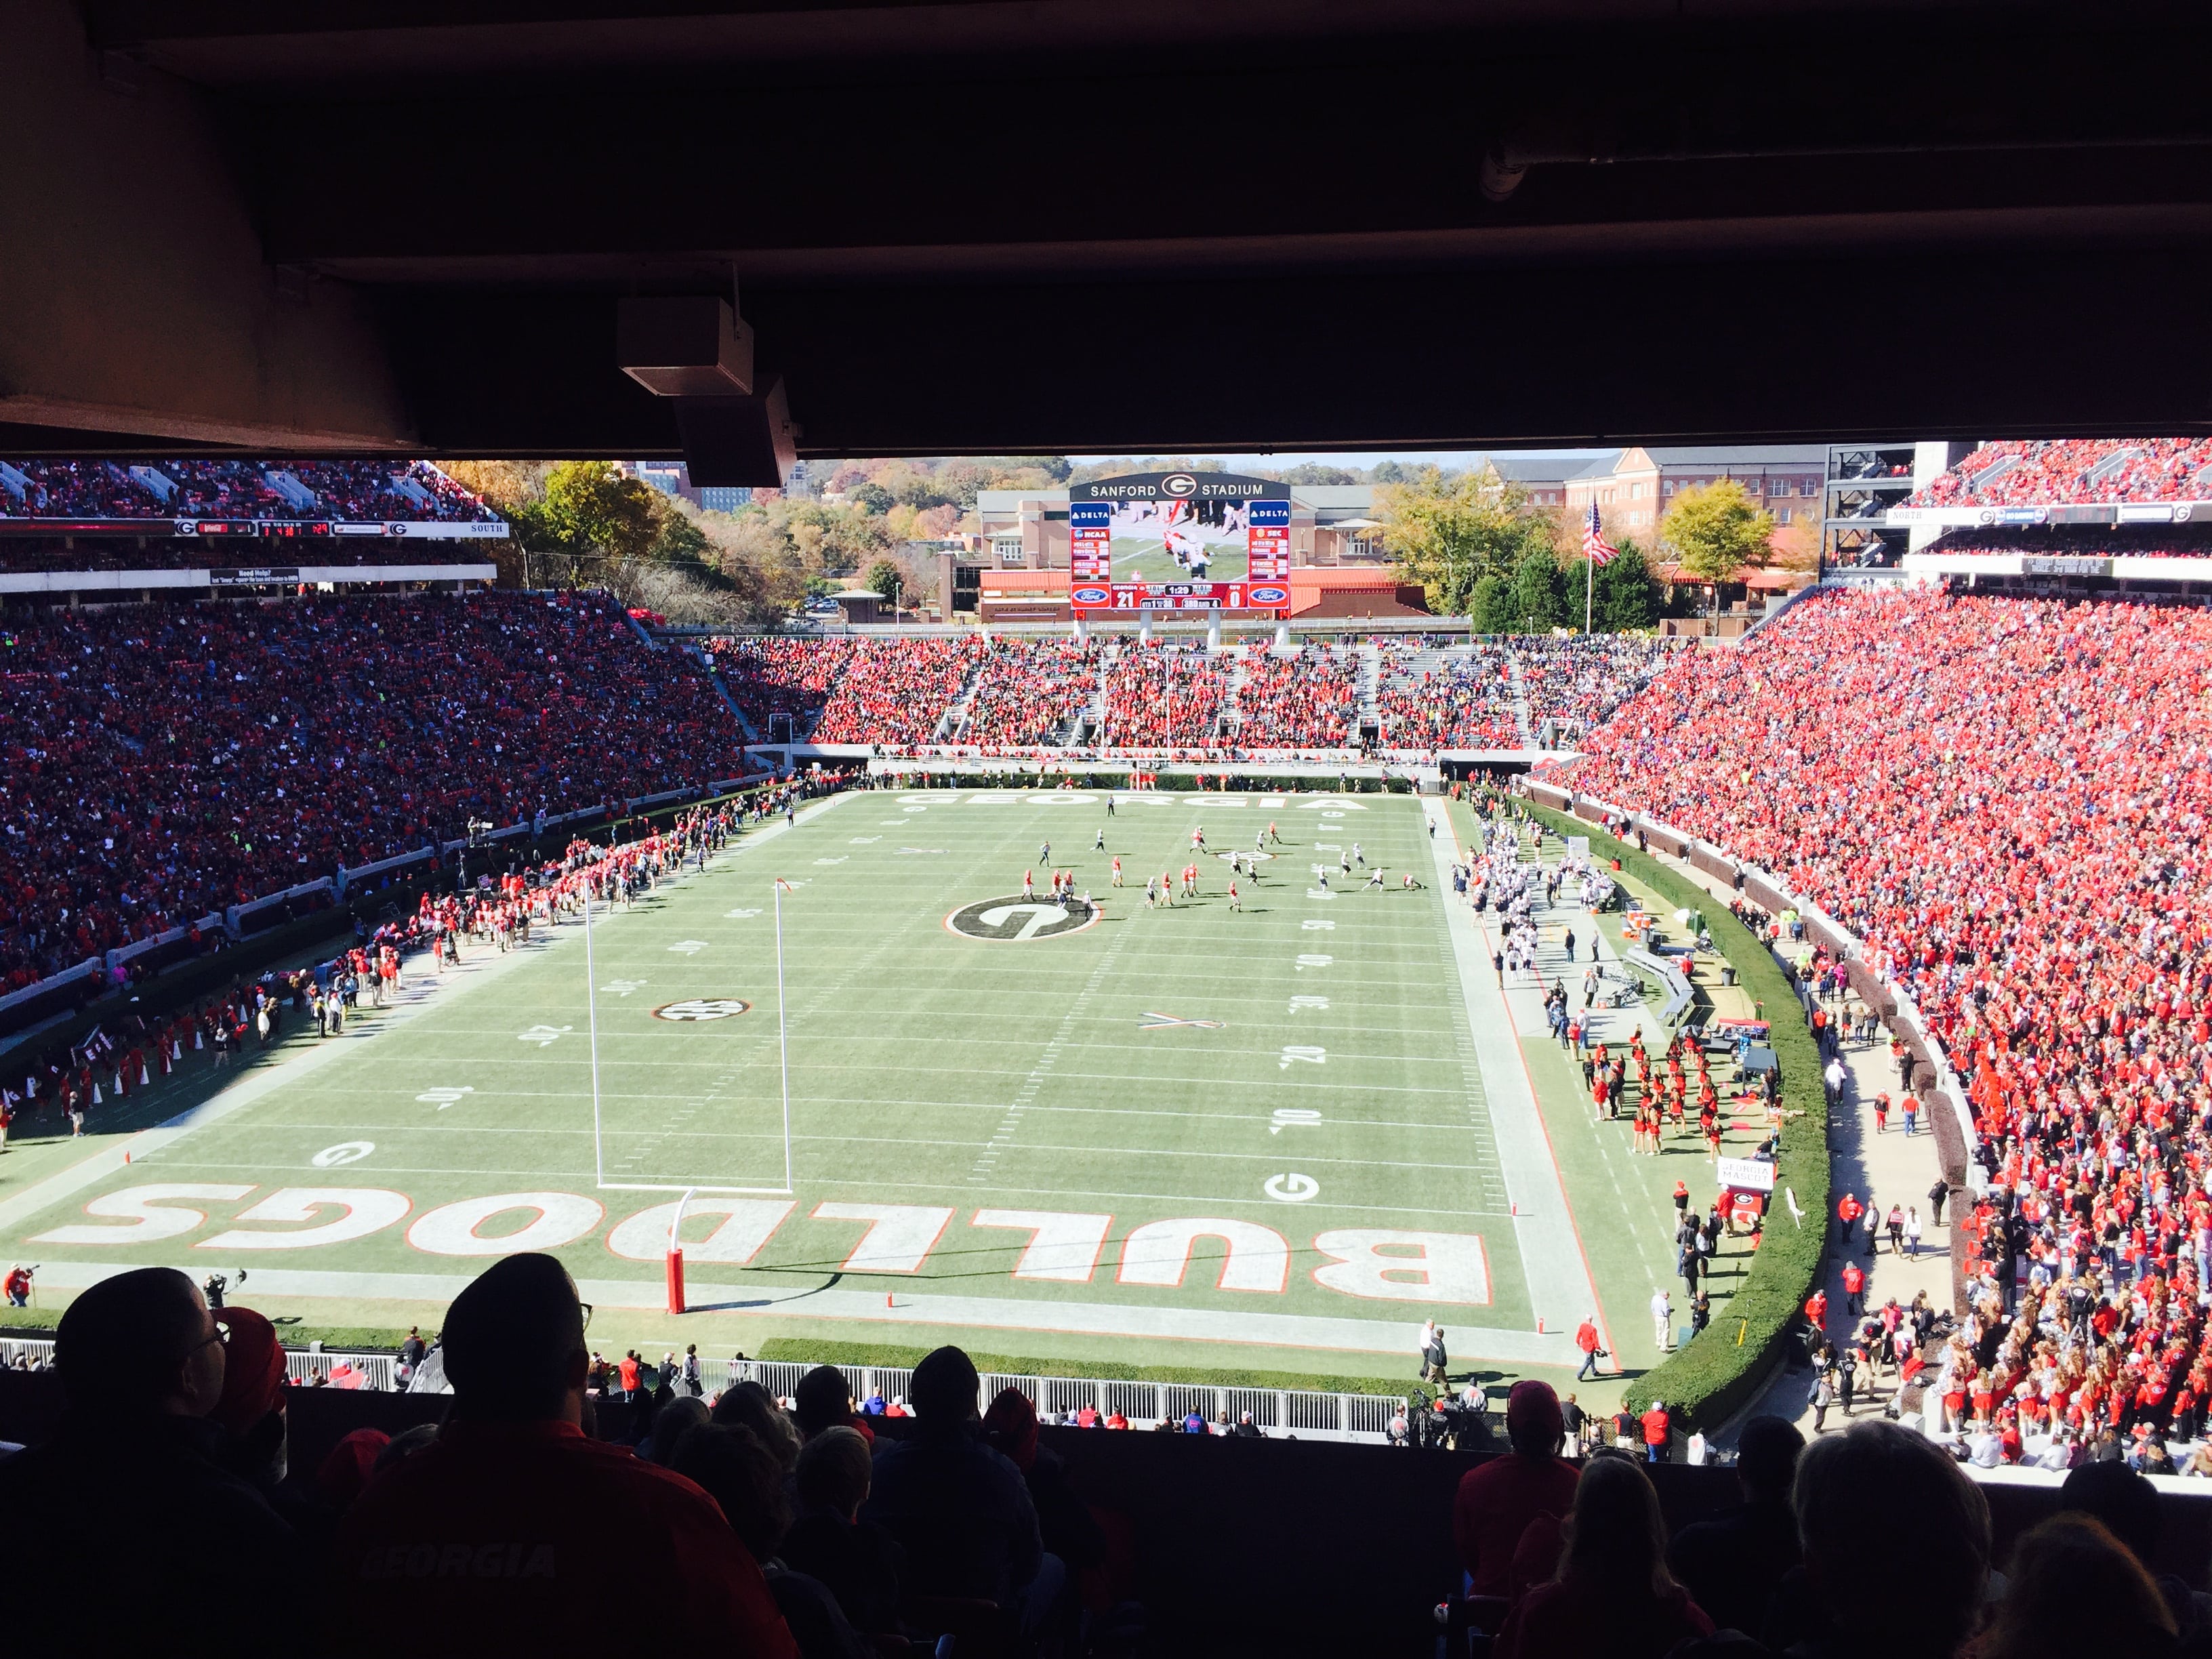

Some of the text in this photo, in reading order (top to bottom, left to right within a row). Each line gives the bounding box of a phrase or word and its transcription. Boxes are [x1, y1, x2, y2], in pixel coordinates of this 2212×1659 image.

[1090, 485, 1263, 497] SANFORD STADIUM
[1161, 474, 1197, 497] G
[1893, 511, 1922, 520] NORTH
[1081, 591, 1101, 600] Ford
[1117, 592, 1134, 607] 21
[1230, 592, 1240, 607] 0
[1258, 590, 1278, 600] Ford
[895, 794, 1368, 810] GEORGIA
[1289, 996, 1329, 1009] 30
[1281, 1046, 1326, 1063] 20
[415, 1086, 474, 1103] 10
[1271, 1108, 1322, 1126] 10
[1723, 1171, 1768, 1182] MASCOT
[1264, 1173, 1320, 1202] G
[26, 1183, 1494, 1306] BULLDOGS
[359, 1542, 556, 1578] GEORGIA
